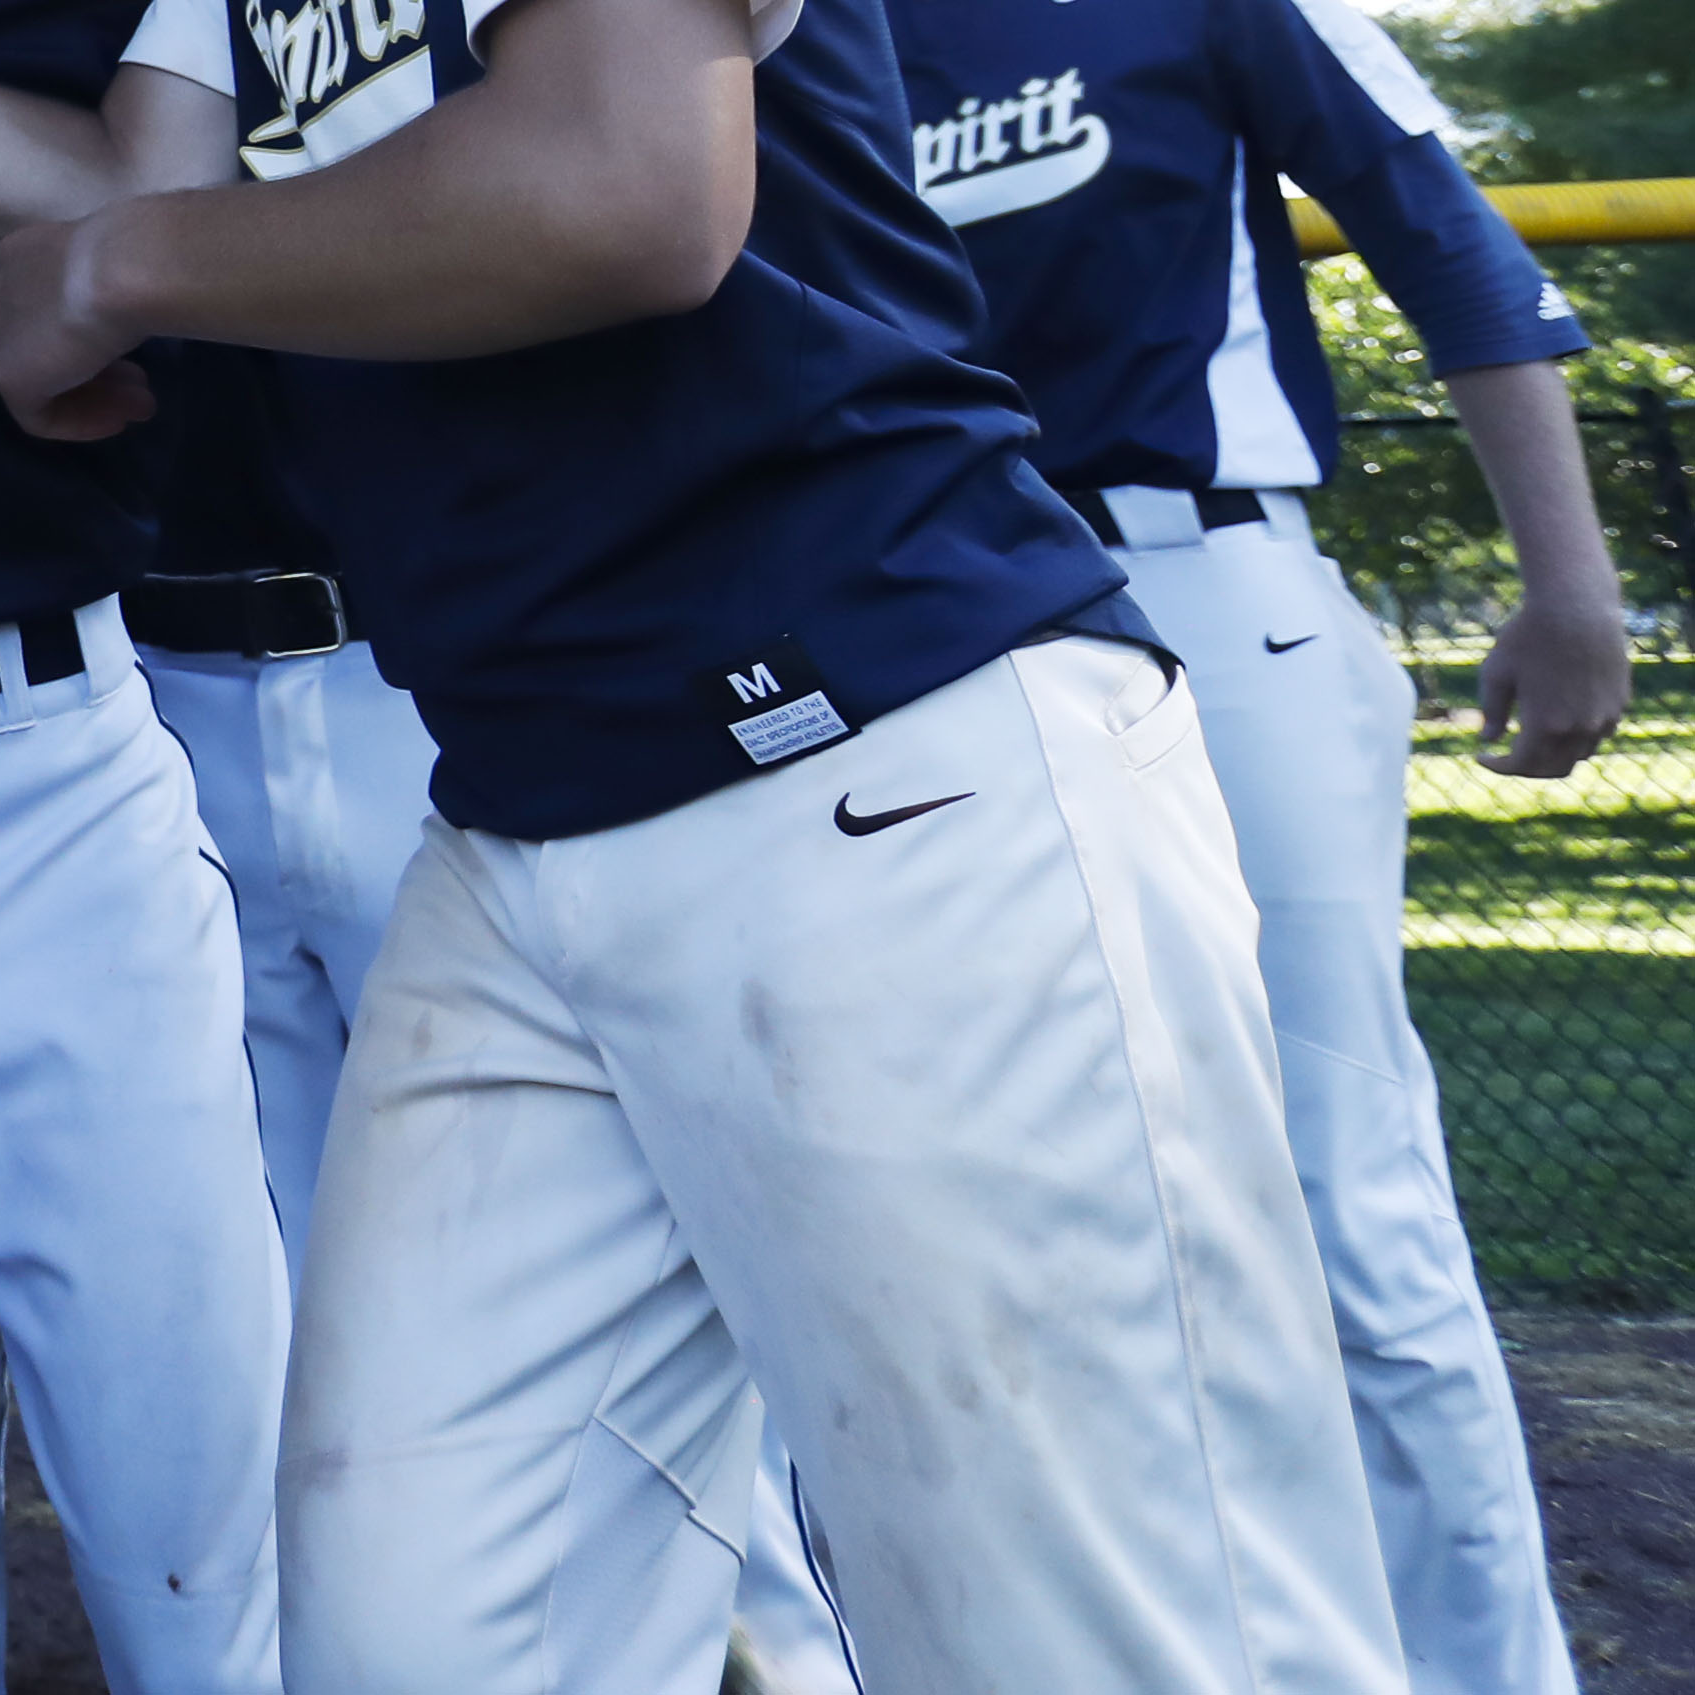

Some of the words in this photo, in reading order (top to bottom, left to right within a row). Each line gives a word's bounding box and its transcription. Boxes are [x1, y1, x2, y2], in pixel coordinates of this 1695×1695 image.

[912, 67, 1086, 197] pirit
[726, 662, 782, 704] M
[791, 706, 804, 717] TO
[804, 698, 823, 711] THE
